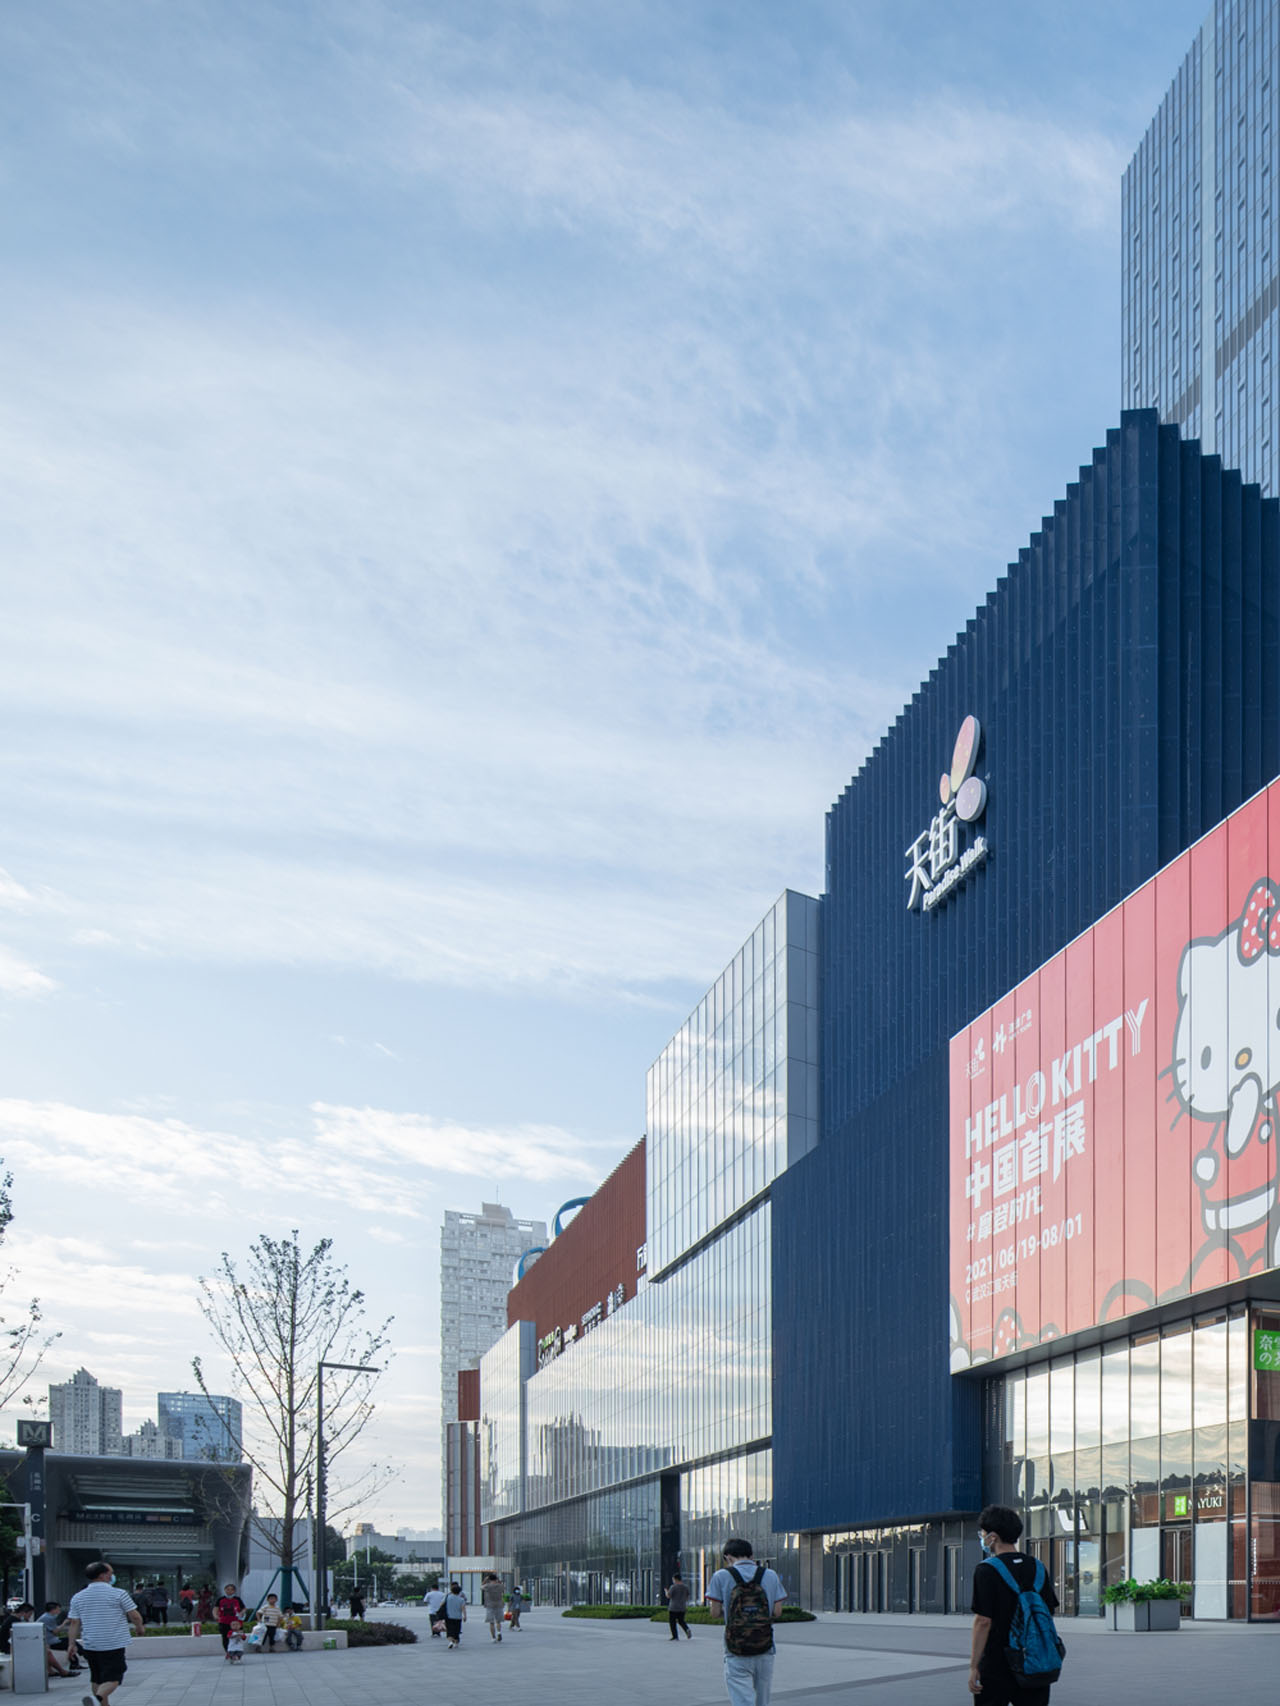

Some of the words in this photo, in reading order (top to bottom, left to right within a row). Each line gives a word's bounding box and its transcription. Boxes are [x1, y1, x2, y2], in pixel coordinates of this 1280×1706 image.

[904, 798, 959, 910] 天街
[965, 1070, 1046, 1160] HELLO
[1051, 998, 1149, 1106] KITTY
[965, 1100, 1086, 1209] 中国首展
[965, 1213, 1083, 1285] 2021/06/19-08/01
